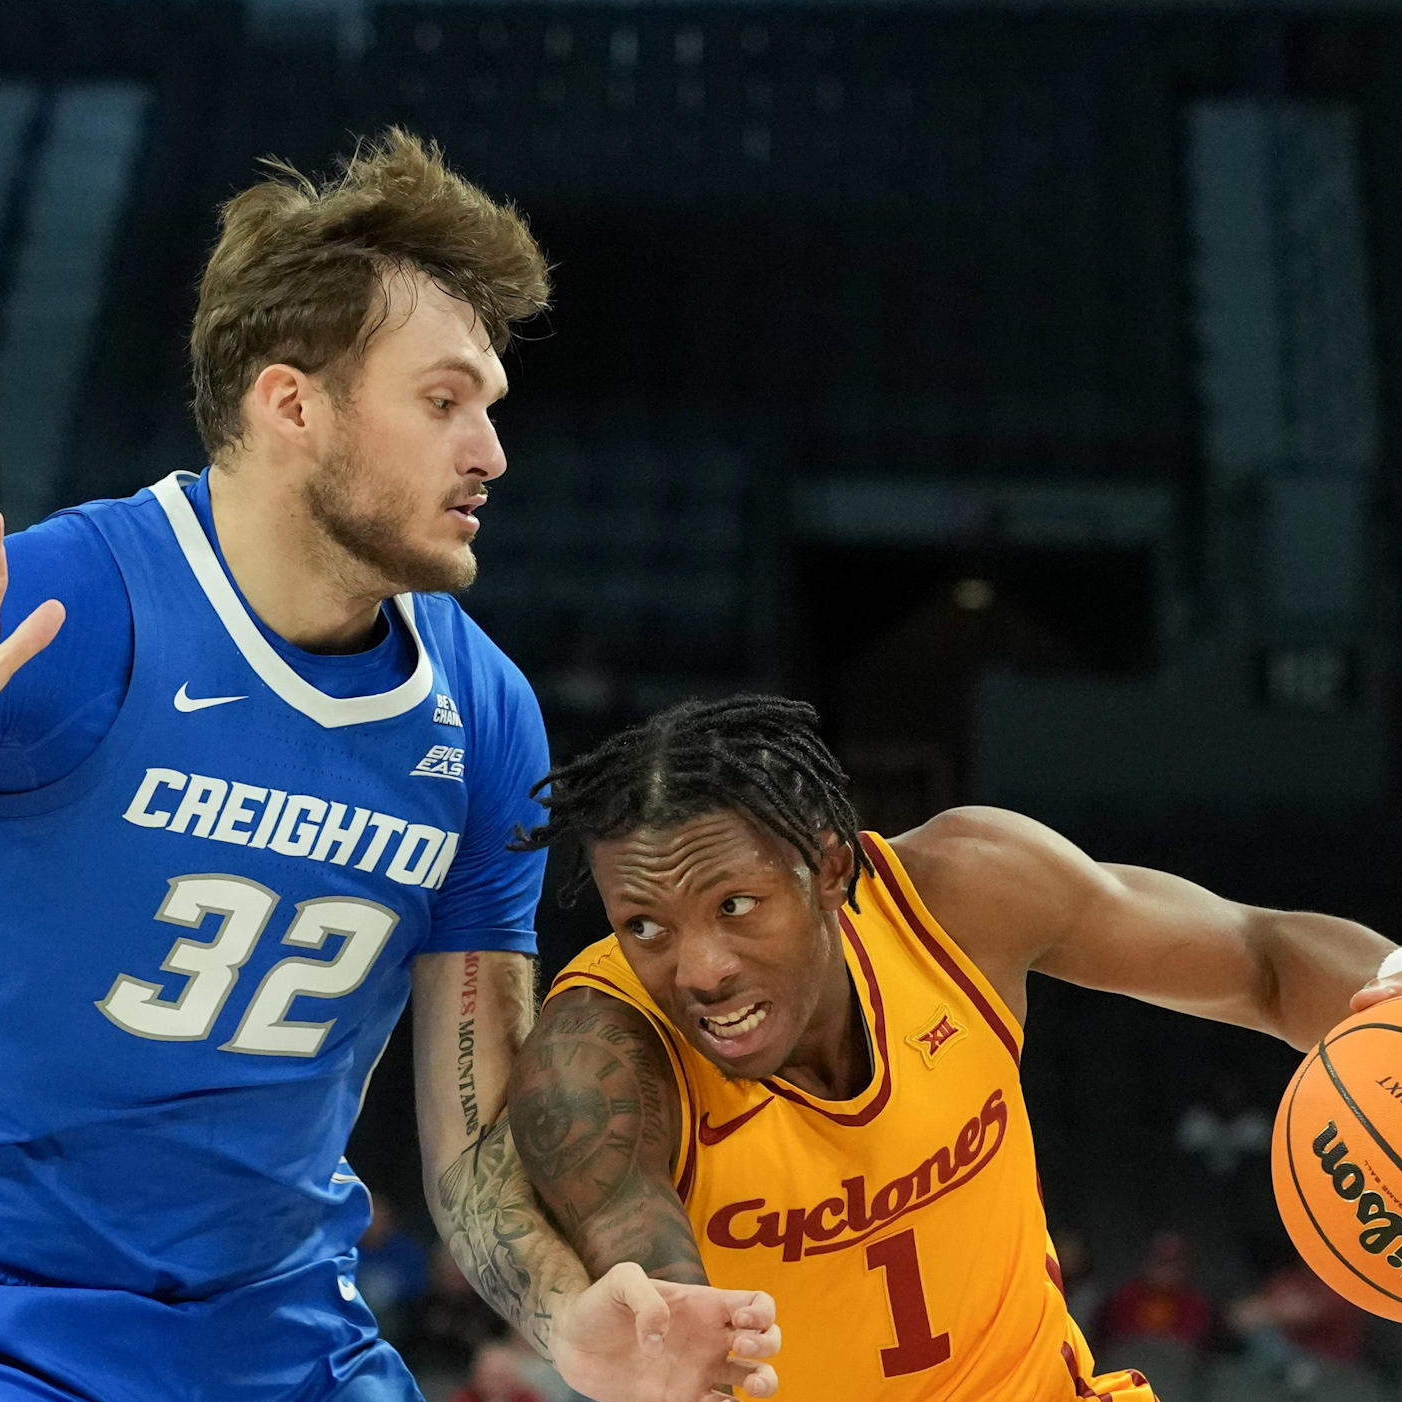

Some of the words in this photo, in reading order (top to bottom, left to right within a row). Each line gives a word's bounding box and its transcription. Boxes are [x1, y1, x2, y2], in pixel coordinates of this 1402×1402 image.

[415, 757, 465, 777] EAS
[426, 745, 465, 762] BIG
[122, 767, 460, 890] CREIGHTON
[94, 872, 401, 1058] 32
[458, 1018, 479, 1136] MOUNTAINS
[706, 1088, 1008, 1263] Cyclones
[1363, 1159, 1382, 1184] BALL
[864, 1226, 951, 1379] 1
